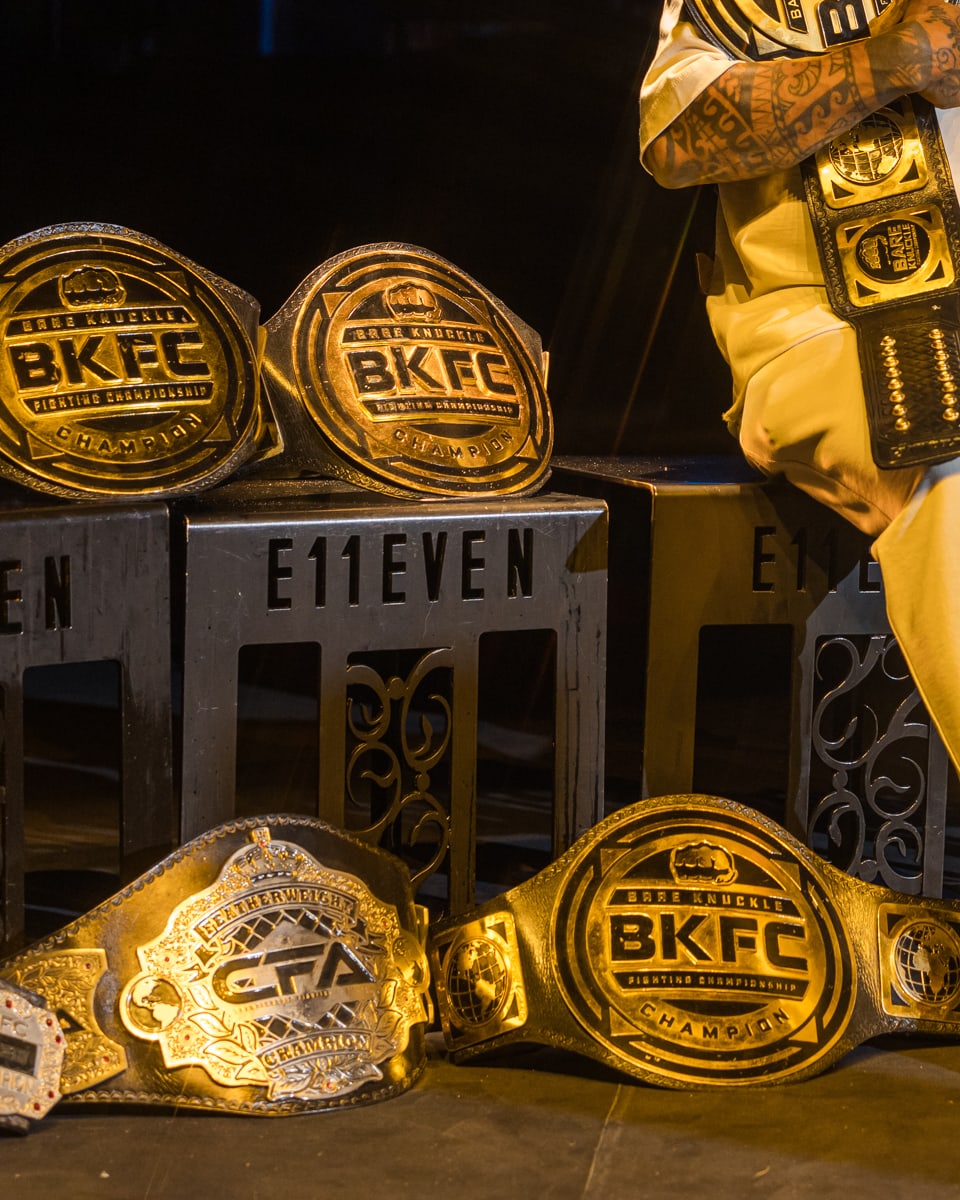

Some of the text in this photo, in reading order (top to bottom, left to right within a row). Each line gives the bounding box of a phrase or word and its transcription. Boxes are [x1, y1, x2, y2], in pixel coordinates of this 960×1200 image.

[888, 224, 908, 272] BARE
[901, 223, 917, 269] KNUCKLE
[22, 310, 174, 332] BARE KNUCKLE
[356, 327, 485, 343] BARE KNUCKLE
[9, 331, 211, 391] BKFC
[346, 346, 517, 396] BKFC
[33, 387, 207, 411] FIGHTING CHAMPIONSHIP
[56, 412, 202, 453] CHAMPION
[393, 427, 514, 460] CHAMPION
[267, 527, 534, 611] E11EVEN
[202, 888, 356, 938] FEATHERWEIGHT
[628, 891, 783, 912] BARE KNUCKLE
[609, 912, 809, 971] BKFC
[212, 941, 377, 1004] CFA
[628, 975, 797, 992] FIGHTING CHAMPIONSHIP
[639, 1002, 790, 1041] CHAMPION
